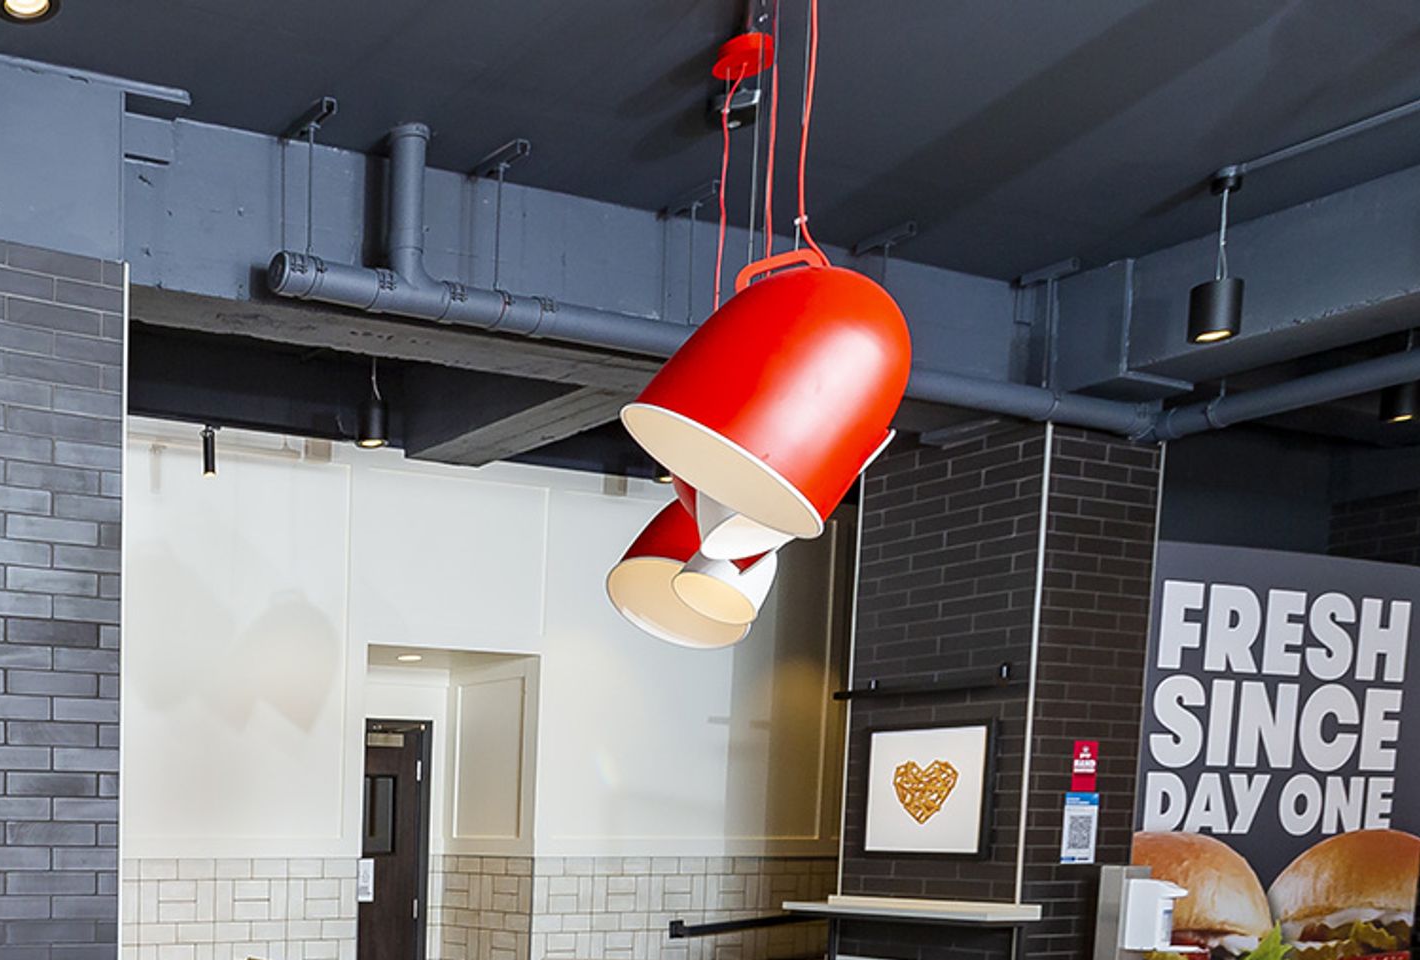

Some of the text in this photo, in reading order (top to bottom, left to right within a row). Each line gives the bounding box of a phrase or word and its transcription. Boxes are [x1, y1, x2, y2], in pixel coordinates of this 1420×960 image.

[1156, 579, 1412, 683] FRESH
[1149, 674, 1403, 772] SINCE
[1143, 771, 1395, 836] DAY ONE
